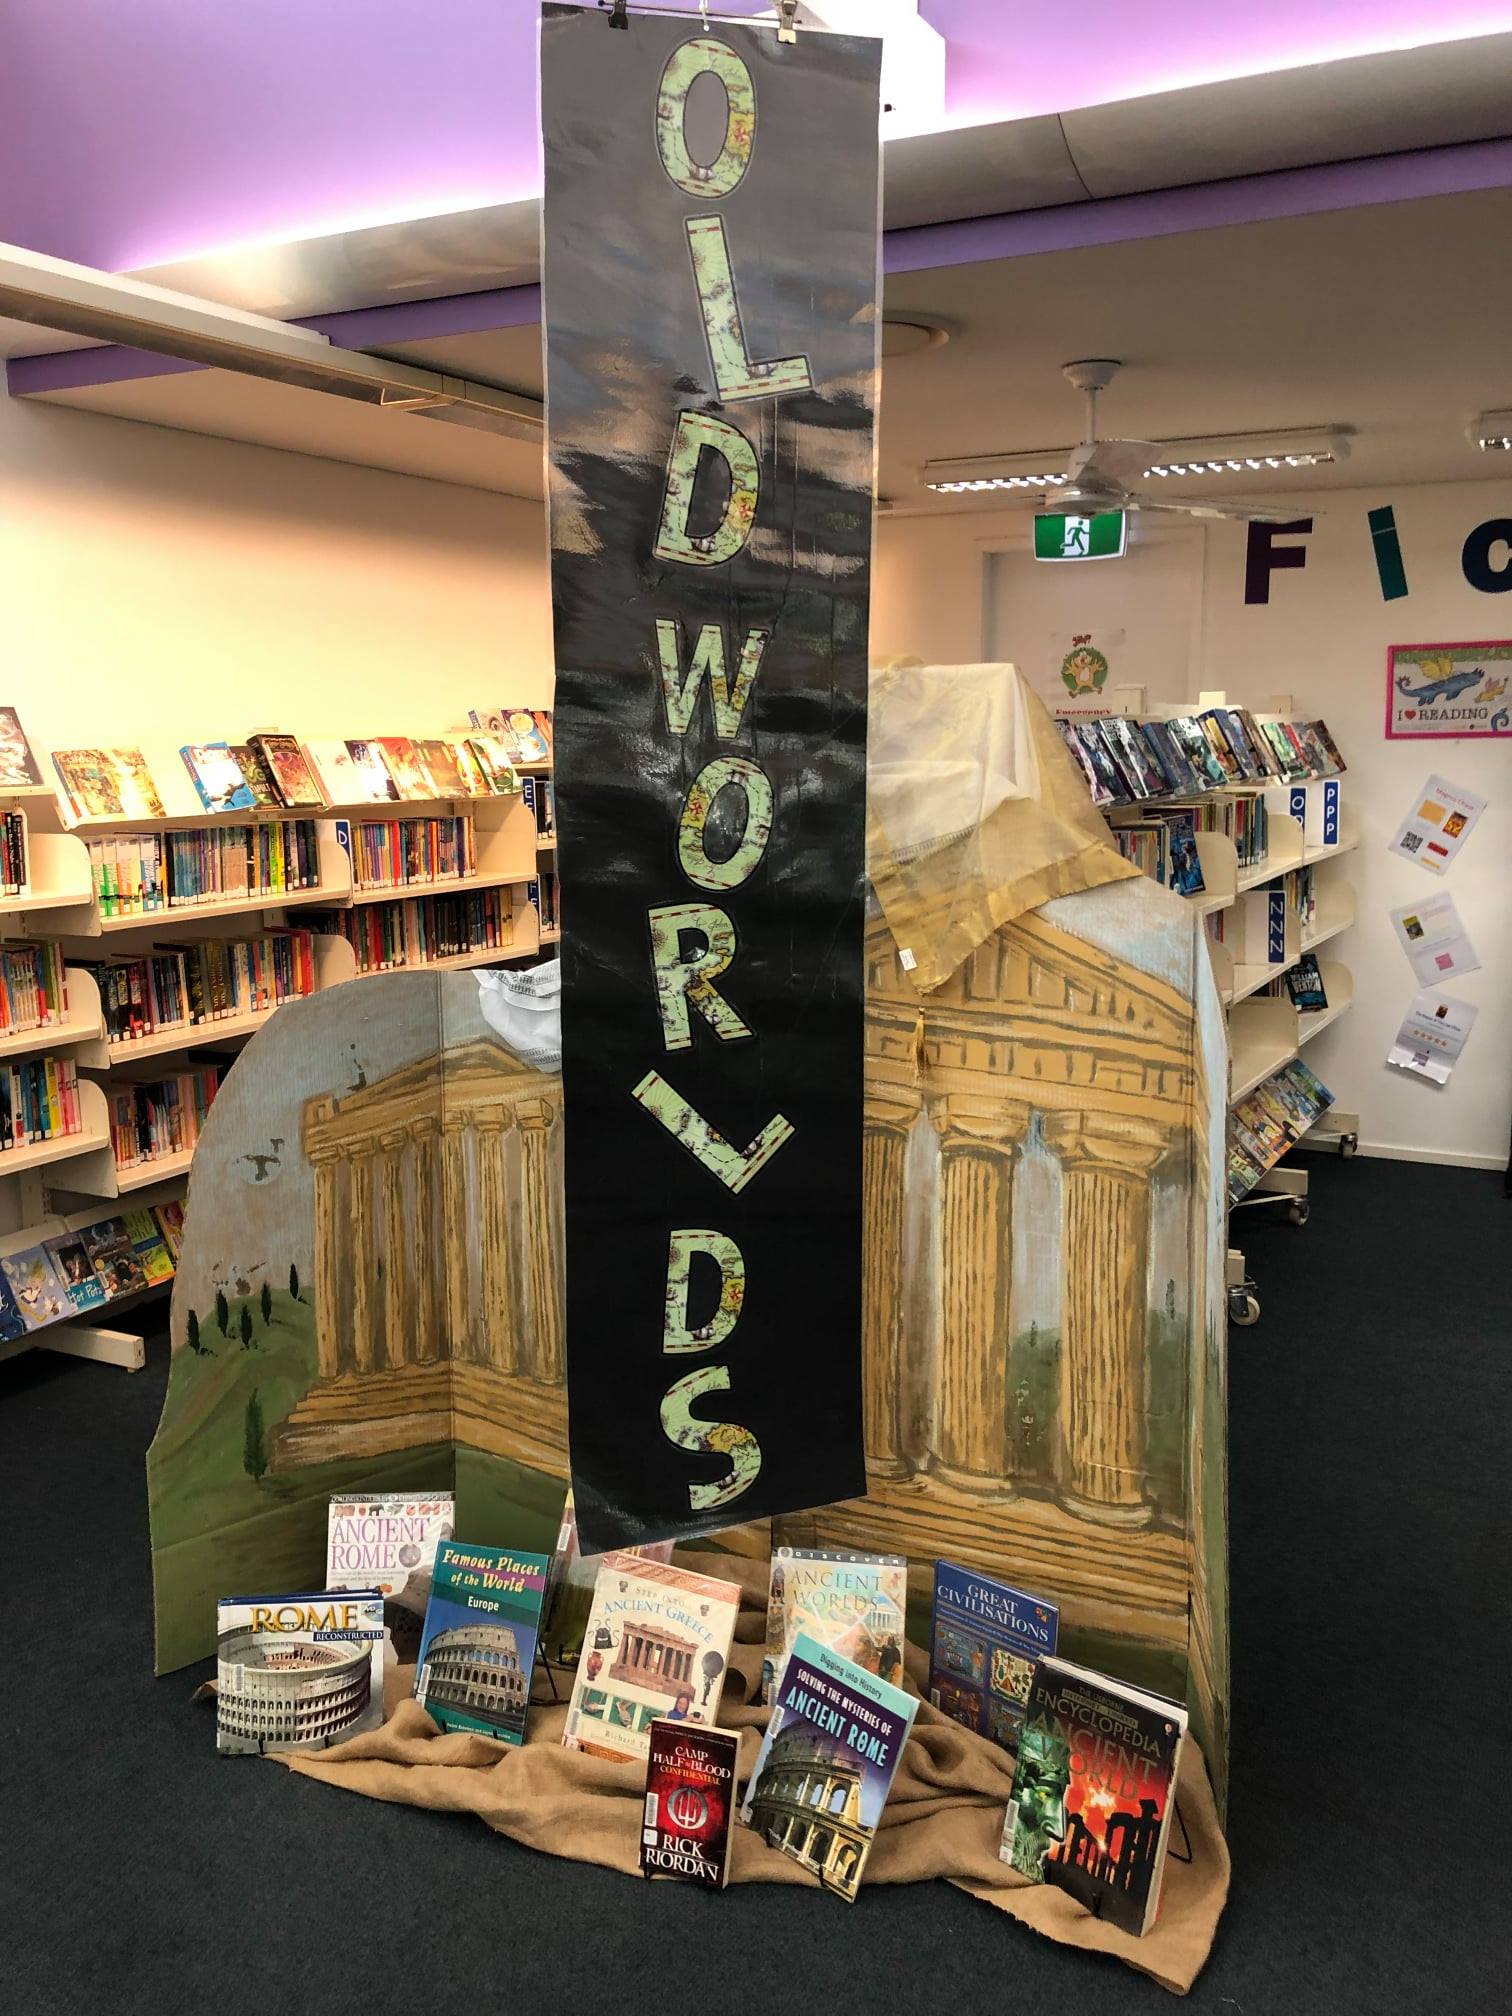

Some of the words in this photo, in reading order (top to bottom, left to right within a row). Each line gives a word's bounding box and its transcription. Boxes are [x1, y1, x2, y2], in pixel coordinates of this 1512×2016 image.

[653, 37, 813, 568] OLD
[1419, 708, 1489, 721] READING
[631, 617, 796, 1511] WORLDS
[331, 1517, 431, 1543] ANCIENT
[331, 1544, 397, 1570] ROME
[442, 1549, 494, 1571] Famous
[496, 1557, 540, 1577] Places
[451, 1572, 462, 1585] of
[463, 1573, 479, 1587] the
[482, 1572, 526, 1593] World
[791, 1570, 883, 1590] ANCIENT
[467, 1595, 499, 1613] Europe
[792, 1589, 879, 1610] WORLDS
[967, 1583, 1019, 1612] GREAT
[249, 1604, 359, 1633] ROME
[603, 1599, 664, 1615] ANCIENT
[666, 1606, 714, 1643] GREECE
[937, 1585, 1049, 1642] CIVILISATIONS
[316, 1631, 384, 1641] RECONSTRUCTED
[819, 1653, 844, 1676] Digging
[845, 1670, 859, 1683] into
[859, 1678, 882, 1700] History
[796, 1668, 827, 1695] SOLVING
[827, 1687, 842, 1704] THE
[841, 1696, 881, 1729] MYSTERIES
[880, 1722, 893, 1736] OF
[785, 1686, 847, 1738] ANCIENT
[846, 1724, 889, 1767] ROME
[1036, 1687, 1161, 1758] ENCYCLOPEDIA
[674, 1746, 709, 1762] CAMP
[1034, 1711, 1158, 1784] ANCIENT
[660, 1765, 722, 1786] CONFIDENTIAL
[663, 1836, 704, 1859] RICK
[645, 1848, 719, 1881] RIORDAN
